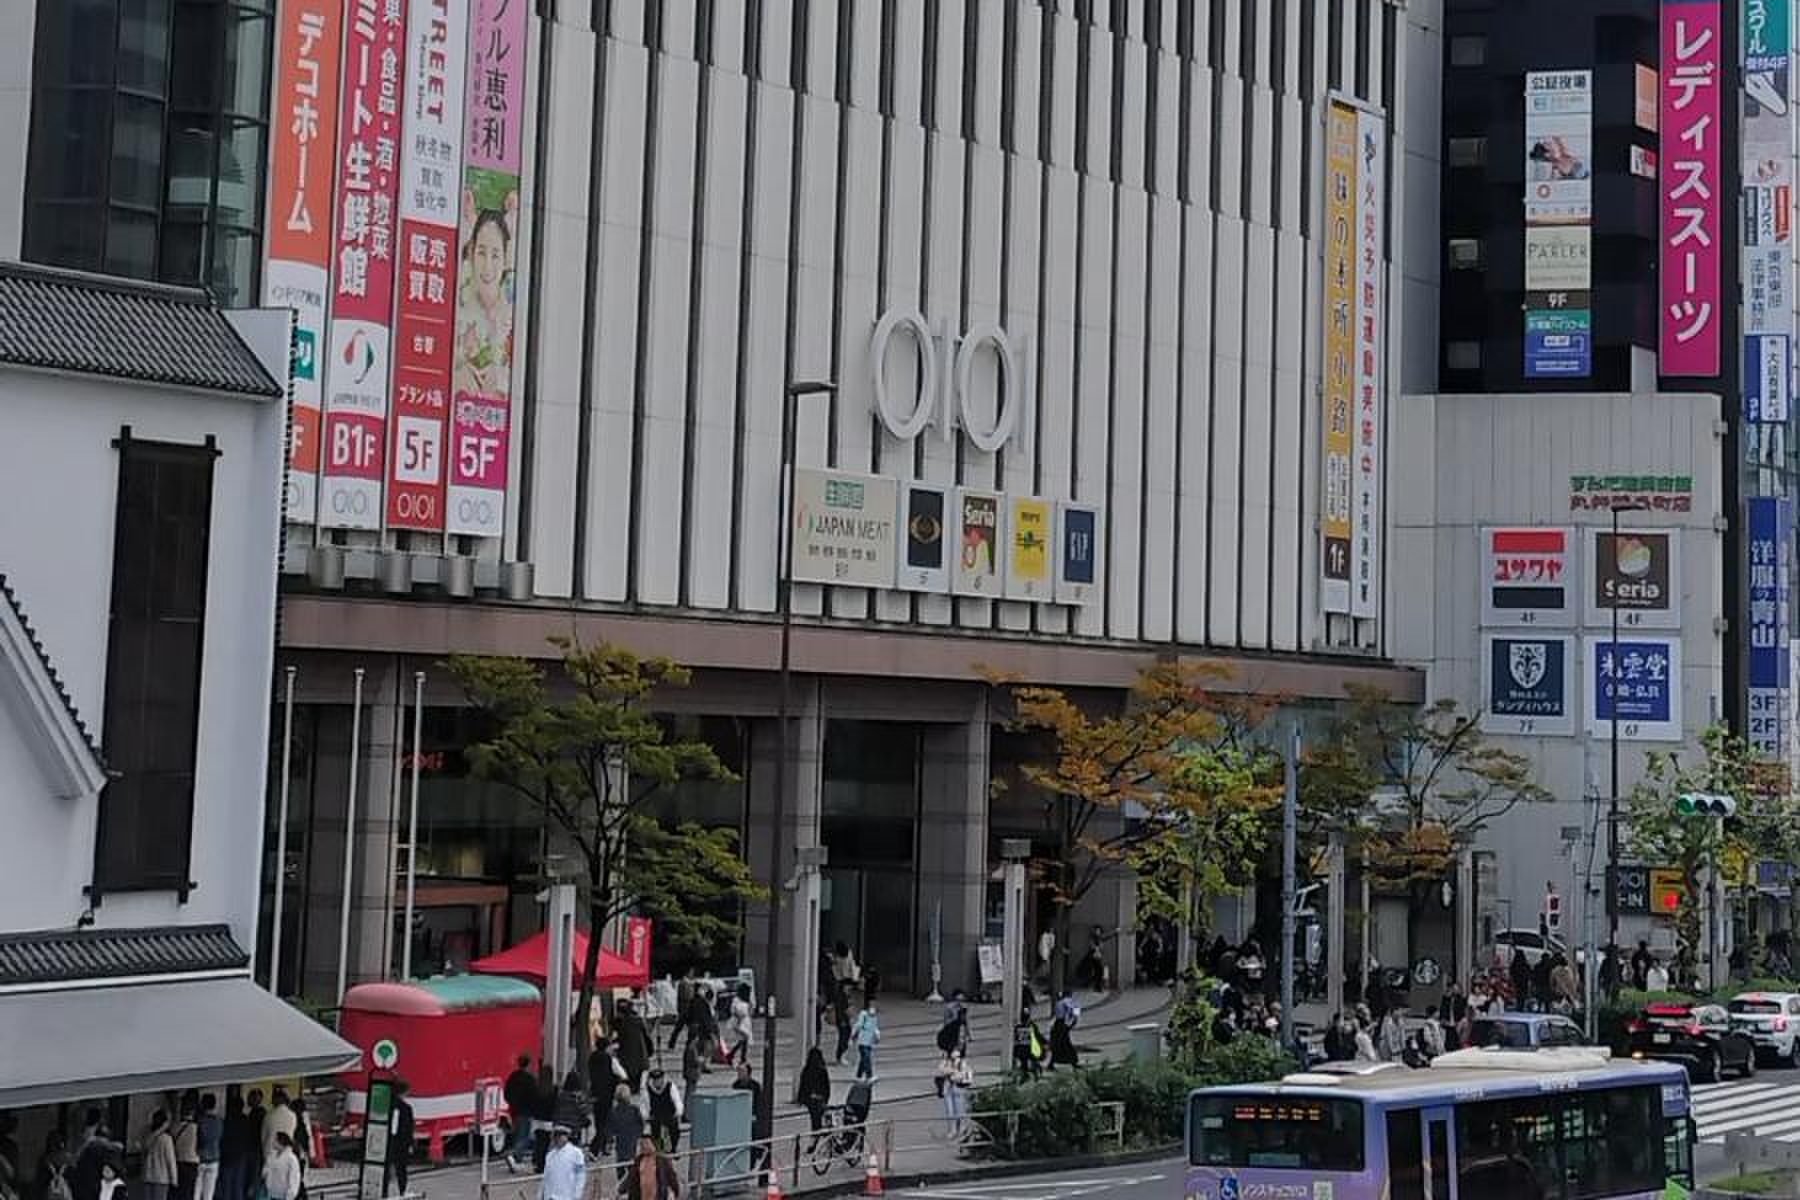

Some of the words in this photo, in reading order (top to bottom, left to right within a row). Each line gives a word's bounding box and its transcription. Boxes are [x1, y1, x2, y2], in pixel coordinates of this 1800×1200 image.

[287, 12, 326, 234] デコホーム
[1668, 20, 1714, 342] レディススーツ
[409, 233, 448, 269] 販売
[407, 270, 446, 306] 買取
[289, 424, 304, 457] F
[332, 422, 377, 467] B1F
[404, 429, 433, 472] 5F
[459, 436, 500, 479] 5F
[816, 514, 856, 538] JAPAN
[1605, 580, 1660, 598] Seria
[1750, 695, 1776, 711] 3F
[1750, 718, 1776, 733] 2F
